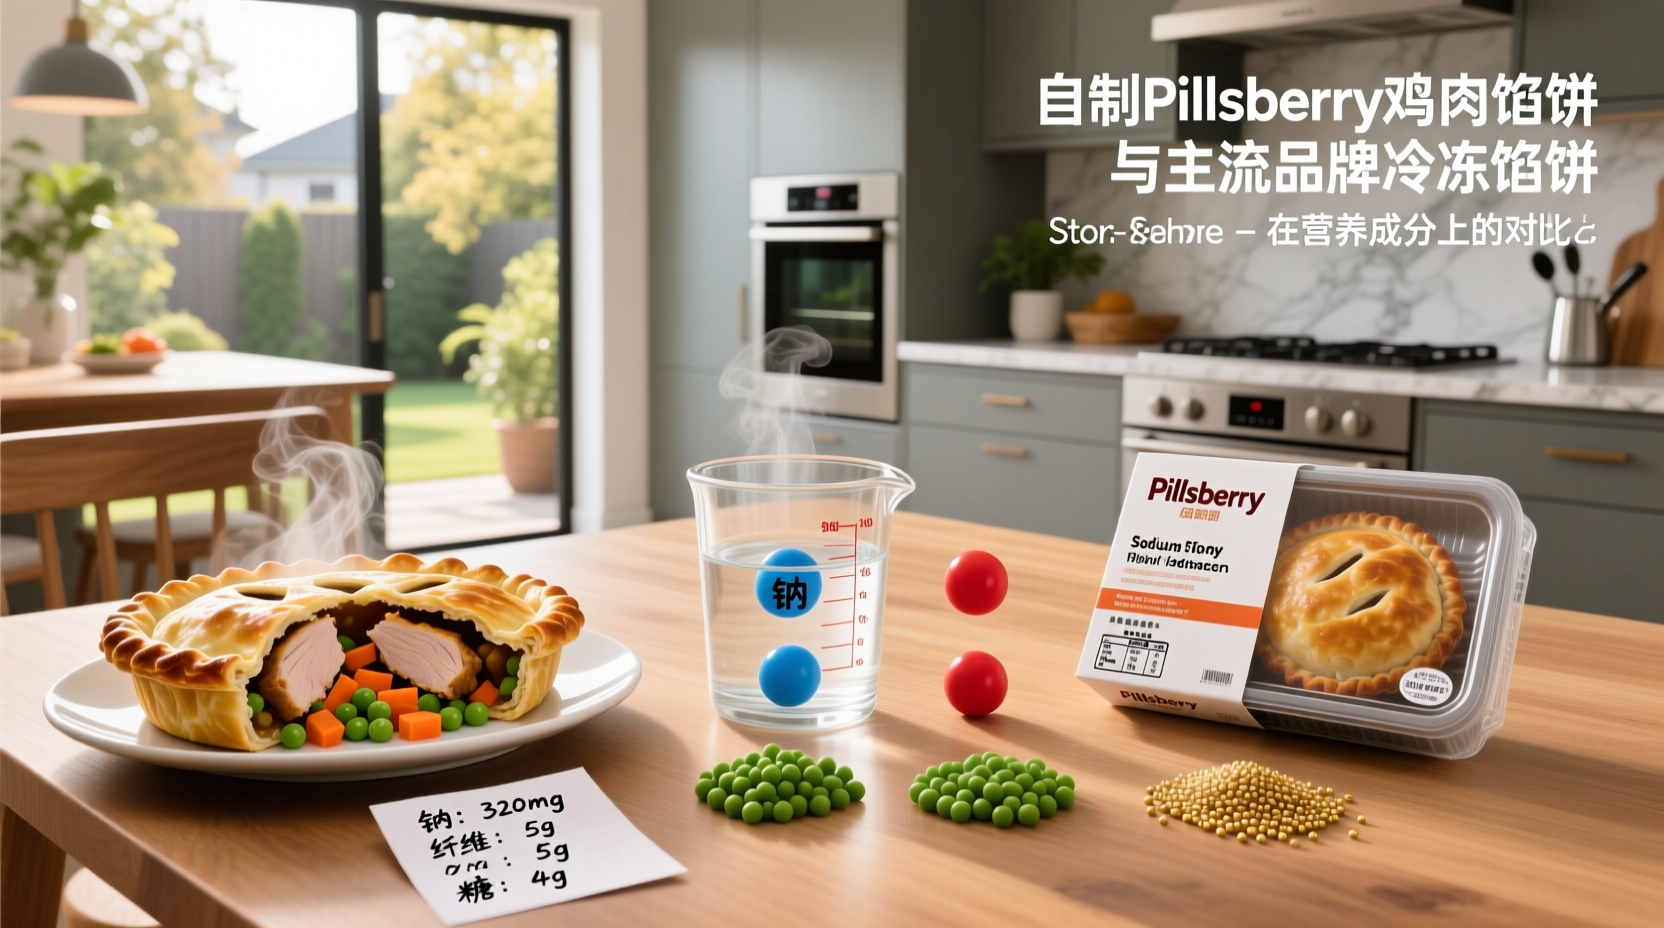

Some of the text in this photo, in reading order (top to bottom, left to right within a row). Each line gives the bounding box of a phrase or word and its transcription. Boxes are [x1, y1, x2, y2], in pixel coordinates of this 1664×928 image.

[1147, 477, 1266, 516] Pillsberry
[772, 576, 808, 611] 钠
[480, 794, 565, 820] 320mg
[525, 820, 555, 838] 5g
[536, 842, 570, 863] 5g
[531, 870, 568, 890] 4g
